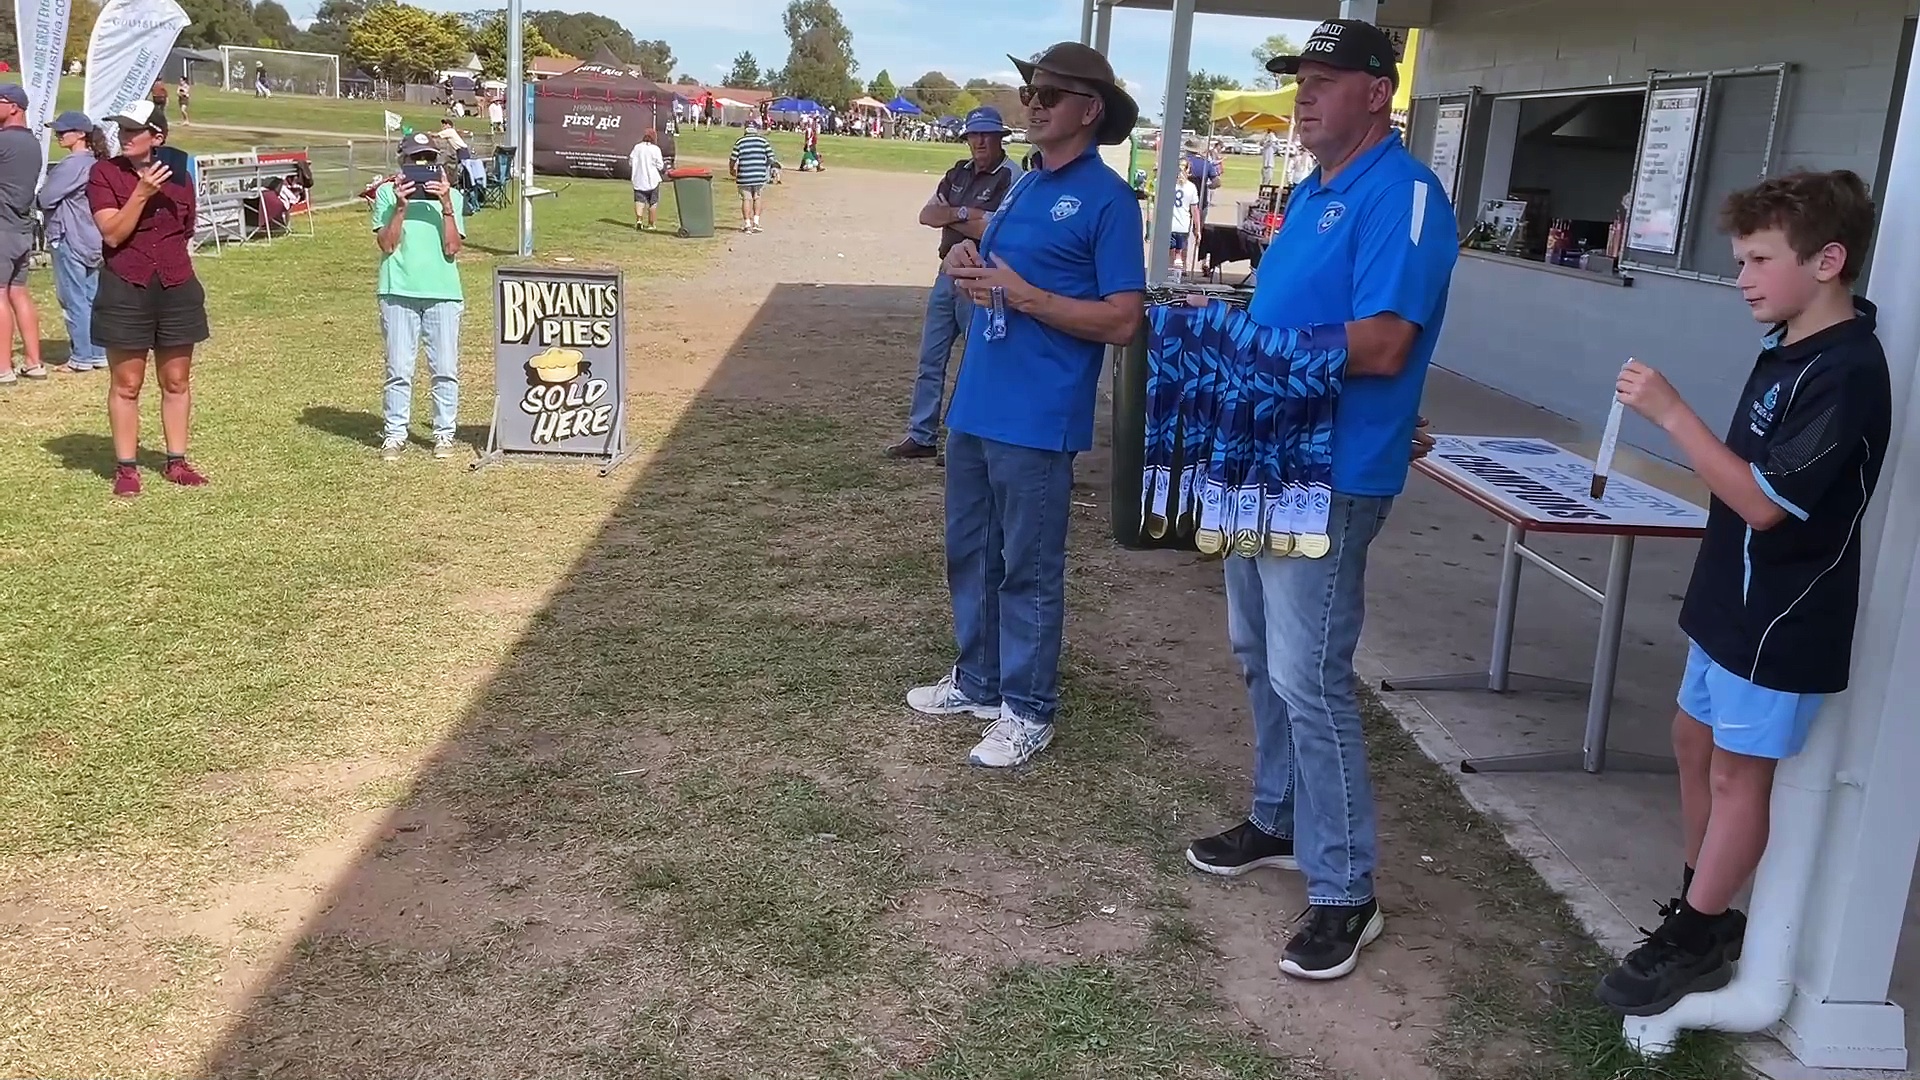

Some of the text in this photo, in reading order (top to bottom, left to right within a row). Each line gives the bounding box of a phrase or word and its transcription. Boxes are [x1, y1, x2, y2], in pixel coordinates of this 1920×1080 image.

[36, 18, 50, 46] GREAT
[34, 46, 47, 71] MORE
[31, 71, 43, 88] FOR
[562, 112, 622, 130] First Aid
[502, 280, 618, 343] BRYANTS
[543, 319, 613, 346] PIES
[522, 379, 608, 414] SOLD
[532, 404, 613, 444] HERE
[1438, 453, 1612, 520] CHAMPIONS
